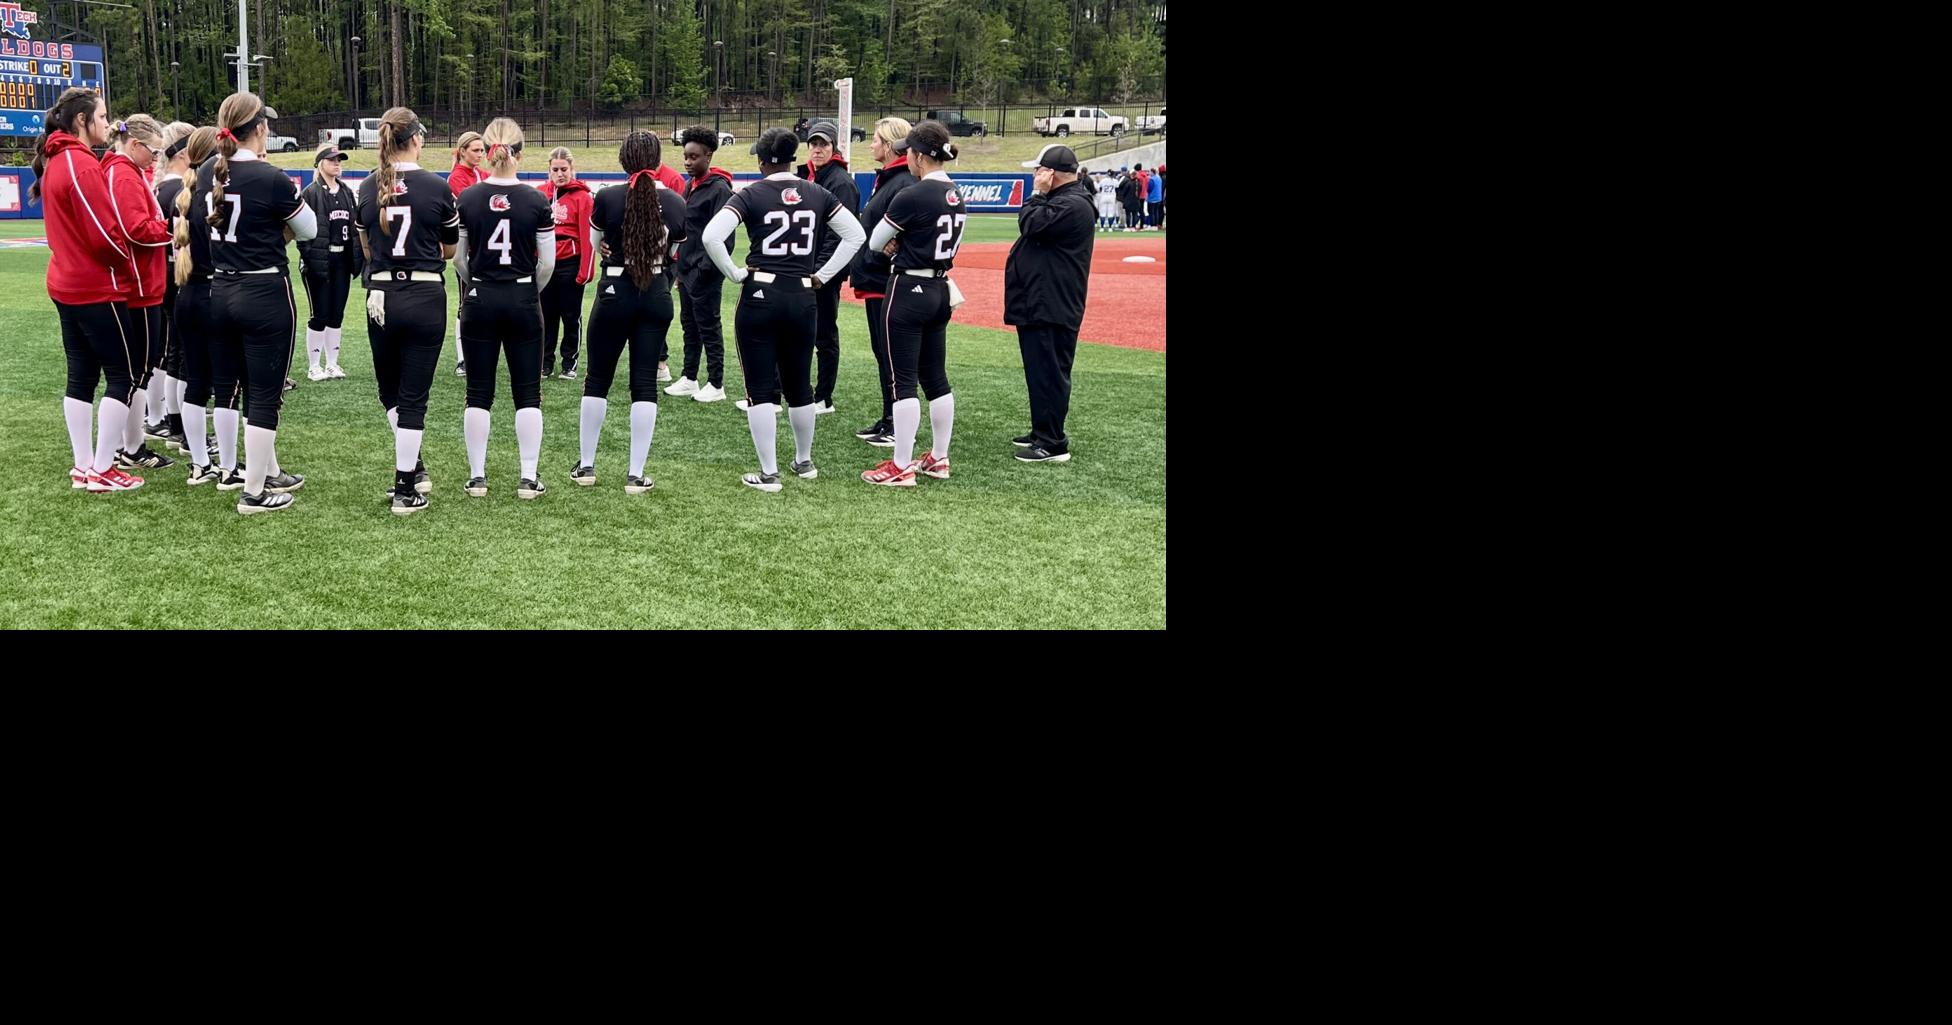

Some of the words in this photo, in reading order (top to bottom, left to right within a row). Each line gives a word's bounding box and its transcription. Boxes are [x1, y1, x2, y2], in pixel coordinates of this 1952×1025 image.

[0, 60, 29, 72] STRIKE
[43, 63, 61, 74] OUT
[62, 62, 70, 77] 2
[1103, 184, 1115, 193] 27
[204, 191, 242, 243] 17
[342, 225, 349, 241] 9
[386, 205, 412, 257] 7
[762, 209, 816, 256] 23
[934, 213, 967, 260] 27
[487, 218, 512, 265] 4
